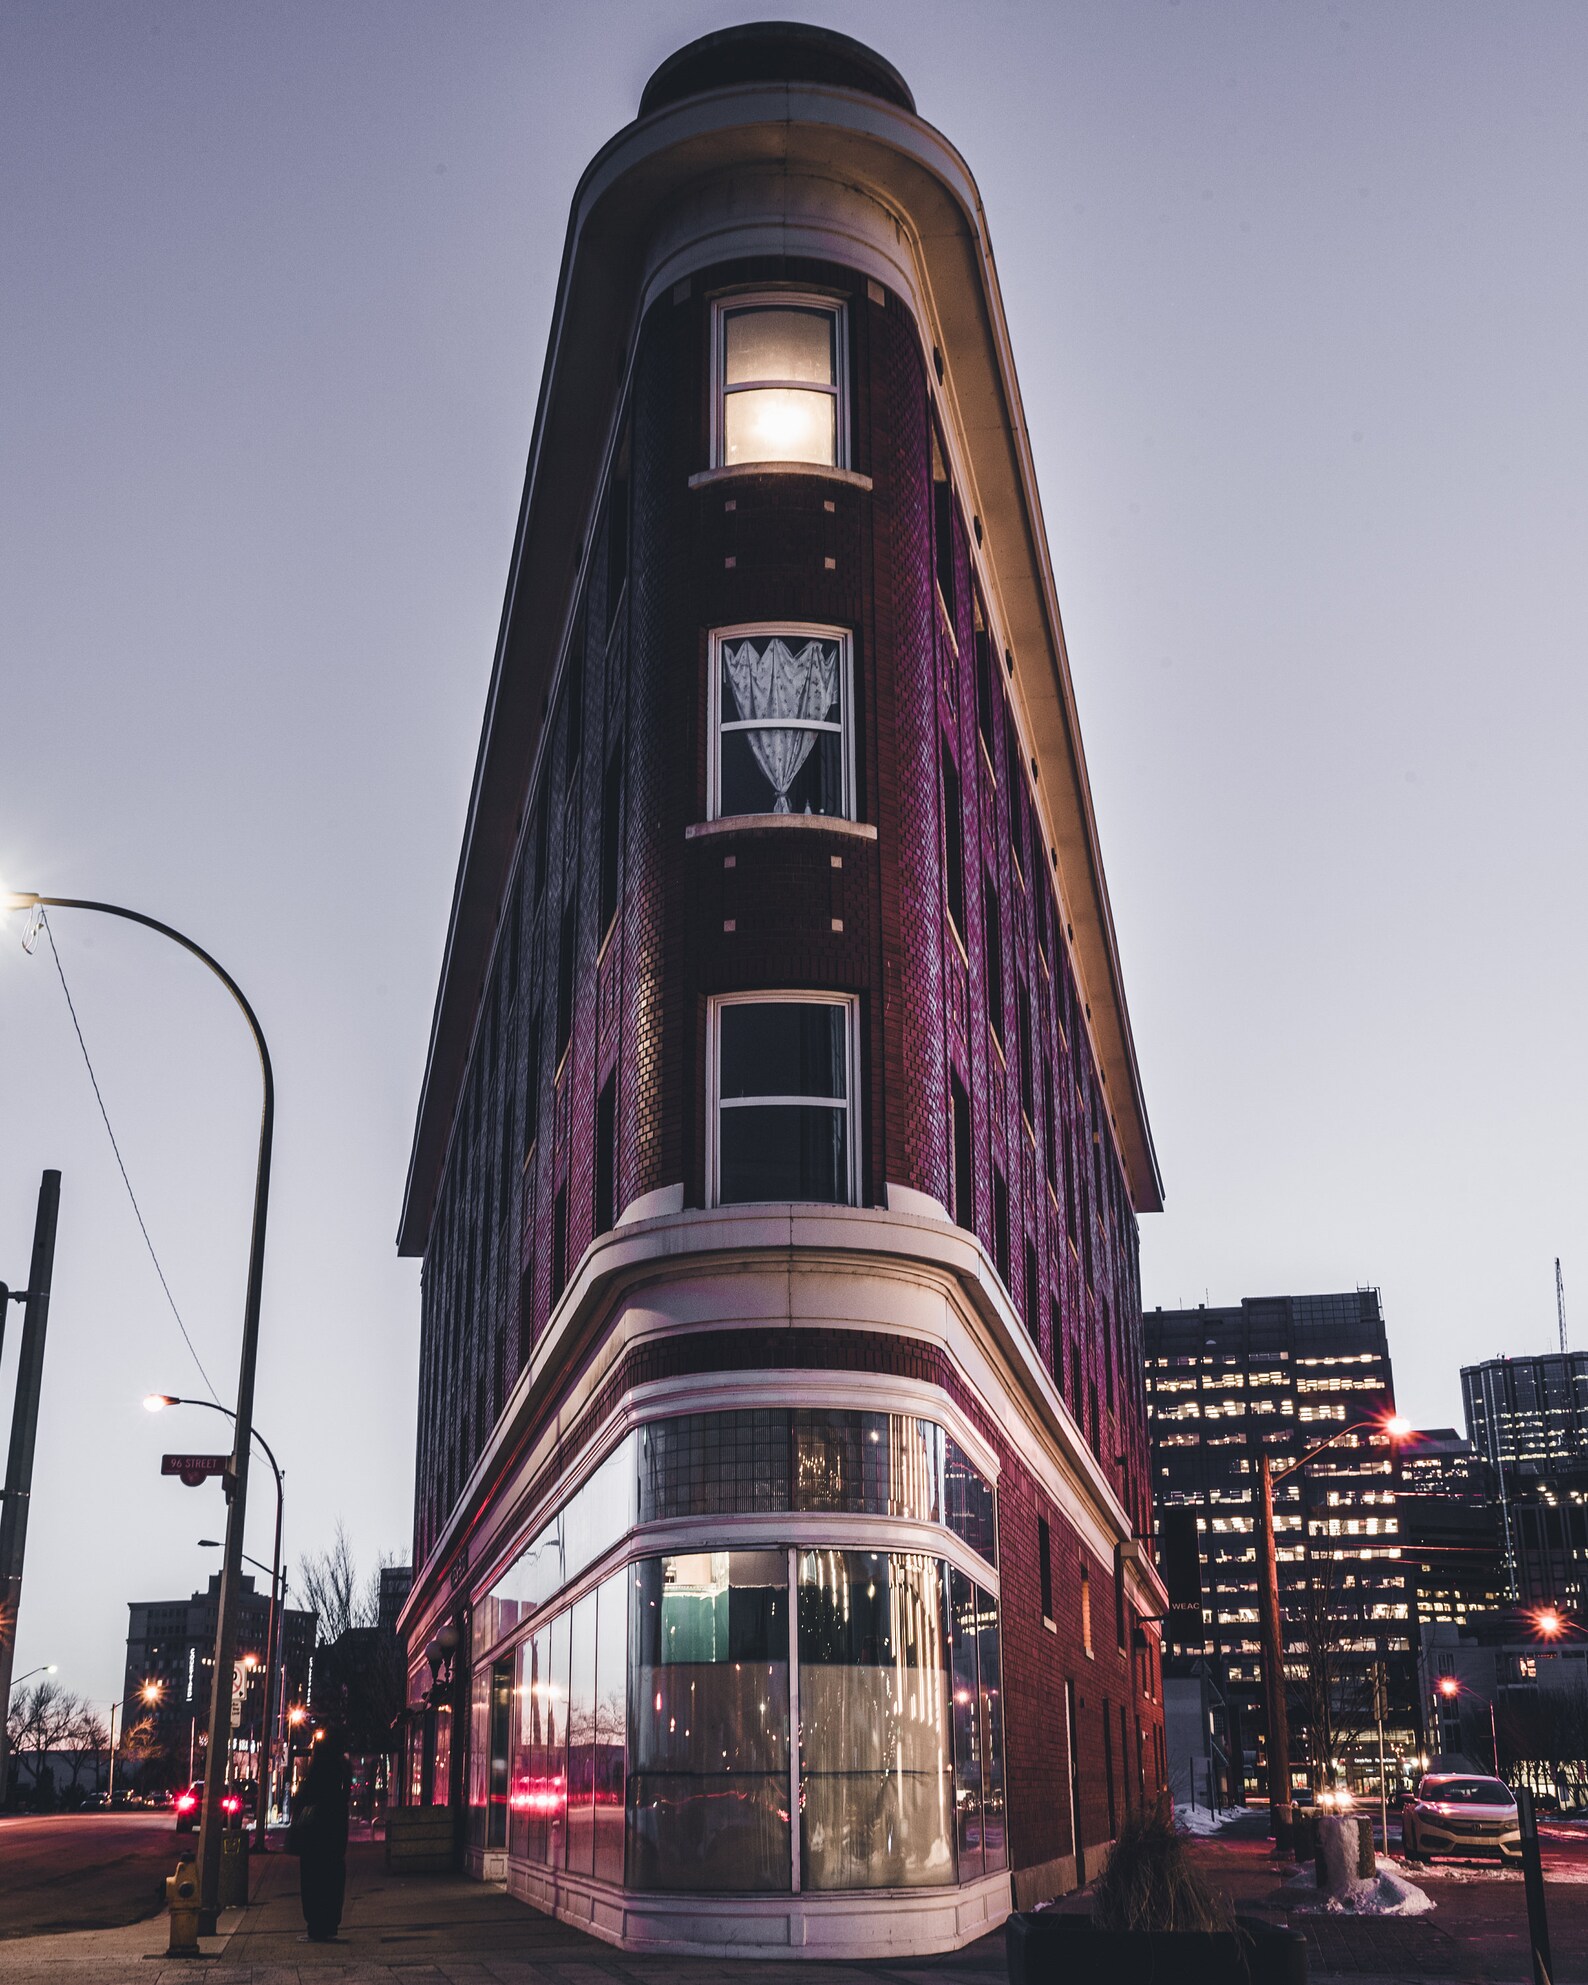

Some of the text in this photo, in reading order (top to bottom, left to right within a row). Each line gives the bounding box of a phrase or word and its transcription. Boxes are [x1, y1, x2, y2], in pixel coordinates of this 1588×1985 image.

[171, 1458, 217, 1469] 96 STREET
[1172, 1602, 1200, 1610] WEAC
